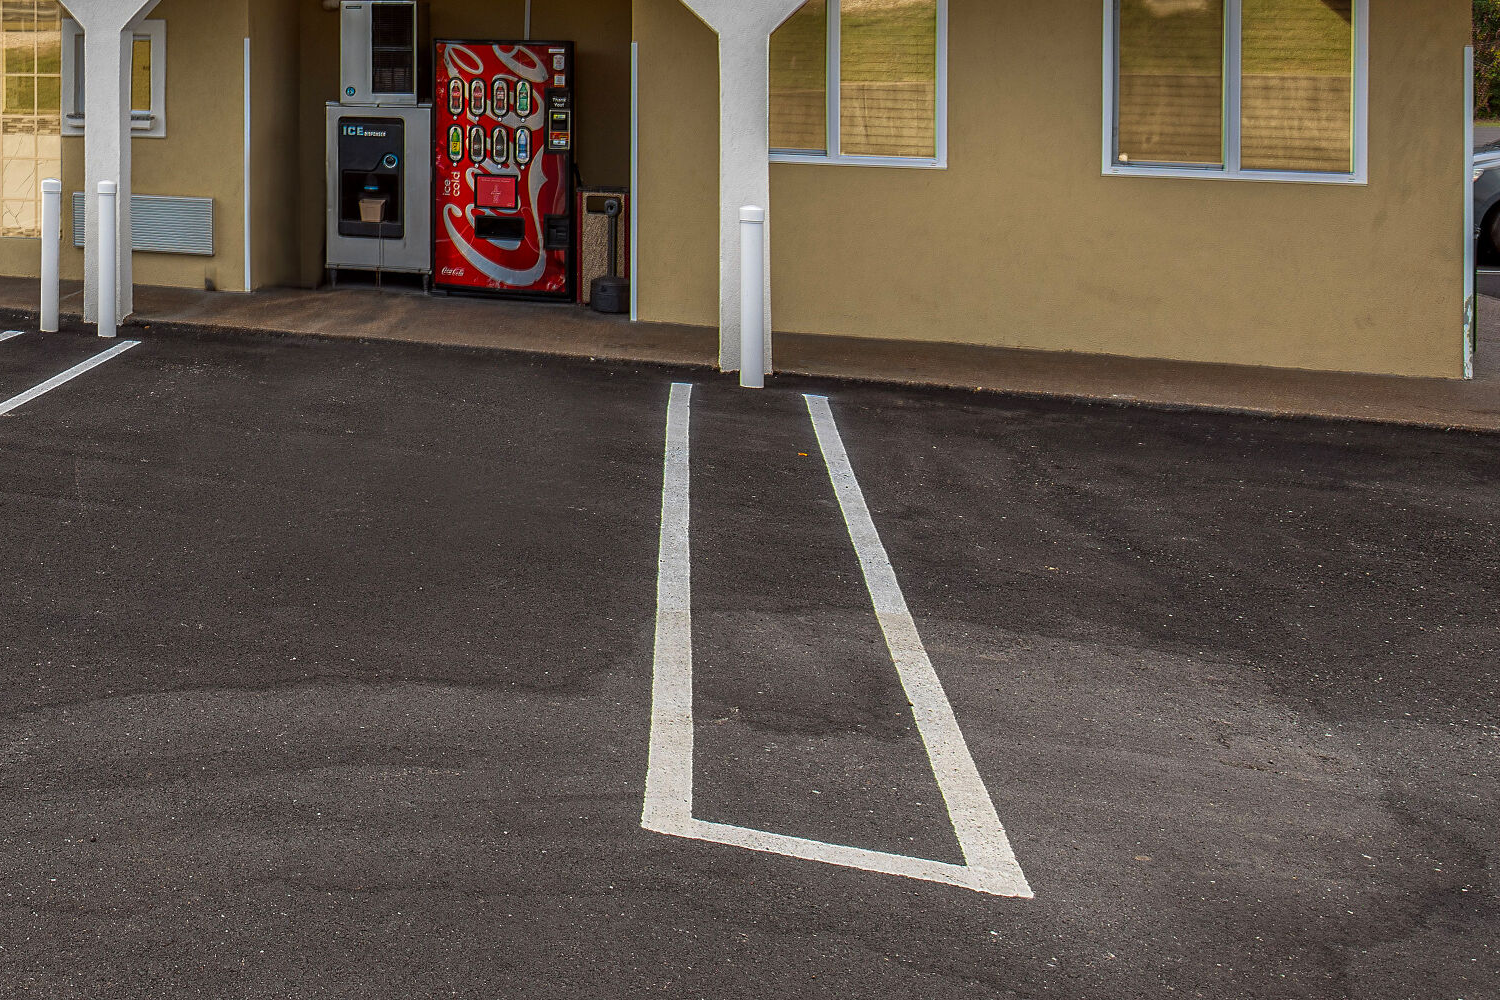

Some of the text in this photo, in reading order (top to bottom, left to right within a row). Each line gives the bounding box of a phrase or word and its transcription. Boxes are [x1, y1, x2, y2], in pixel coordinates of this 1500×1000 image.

[342, 125, 364, 136] ICE
[443, 179, 451, 196] ice
[451, 171, 460, 197] cold
